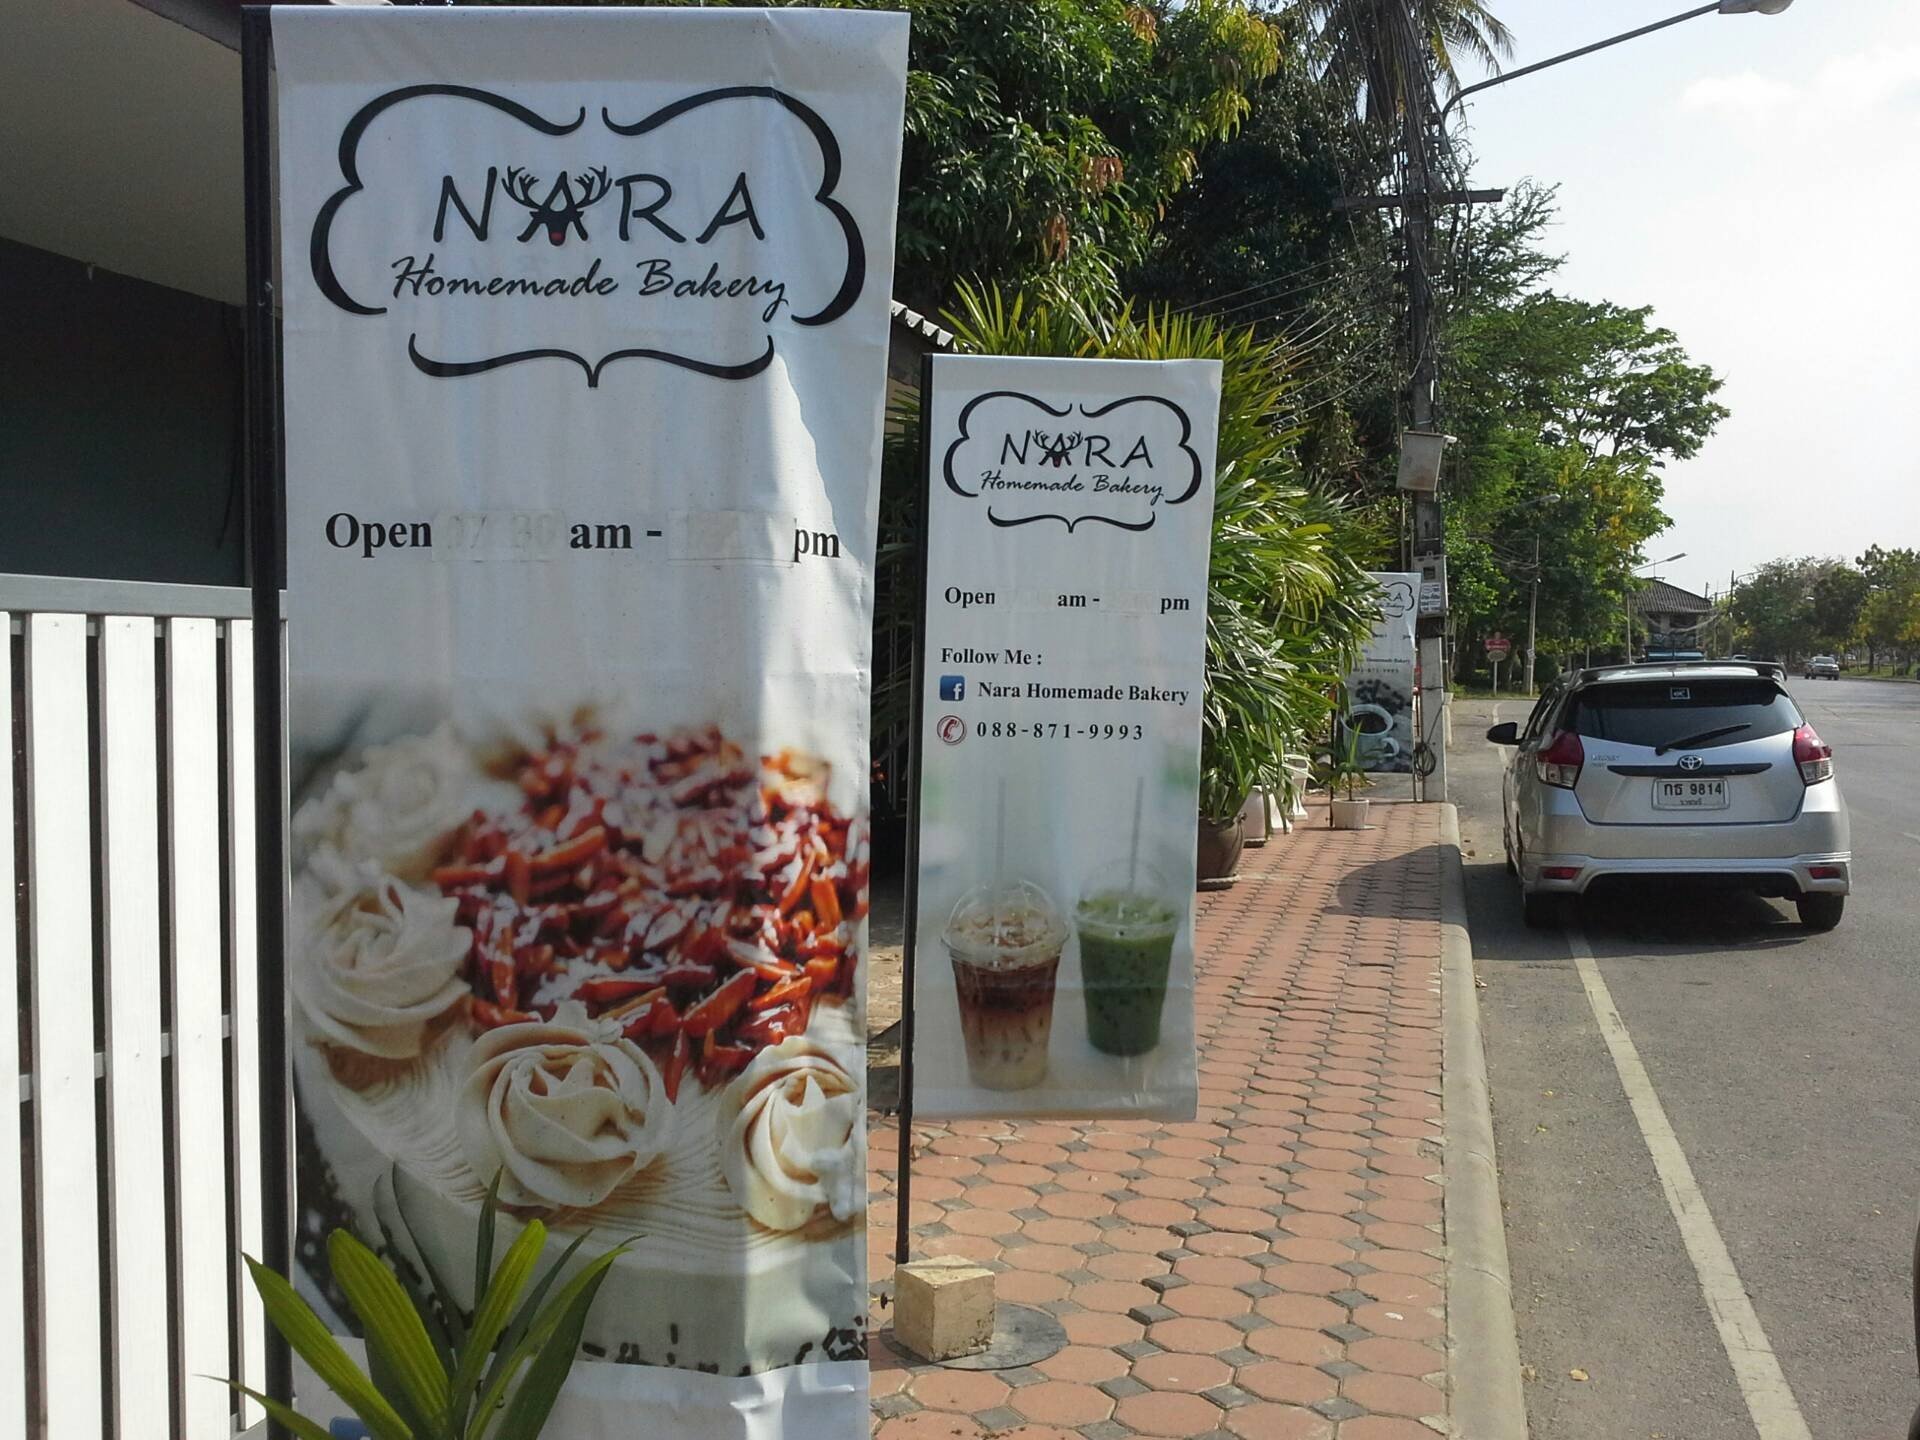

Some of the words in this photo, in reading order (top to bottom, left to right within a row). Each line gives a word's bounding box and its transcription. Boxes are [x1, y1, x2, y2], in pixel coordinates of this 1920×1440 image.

[432, 165, 767, 247] NARA
[391, 252, 620, 299] Homemade
[635, 258, 789, 323] Bakery
[1000, 429, 1154, 469] NARA
[980, 469, 1085, 493] Homemade
[1092, 474, 1165, 506] Bakery
[325, 512, 432, 559] Open
[569, 523, 633, 550] am
[794, 526, 841, 563] pm
[944, 586, 995, 609] Open
[1057, 594, 1087, 608] am
[1159, 597, 1190, 615] pm
[940, 647, 1000, 665] Follow
[1004, 648, 1032, 665] Me
[978, 681, 1021, 698] Nara
[1026, 682, 1124, 701] Homemade
[1128, 685, 1190, 706] Bakery
[976, 721, 1143, 741] 088-871-9993
[1689, 782, 1722, 796] 9814
